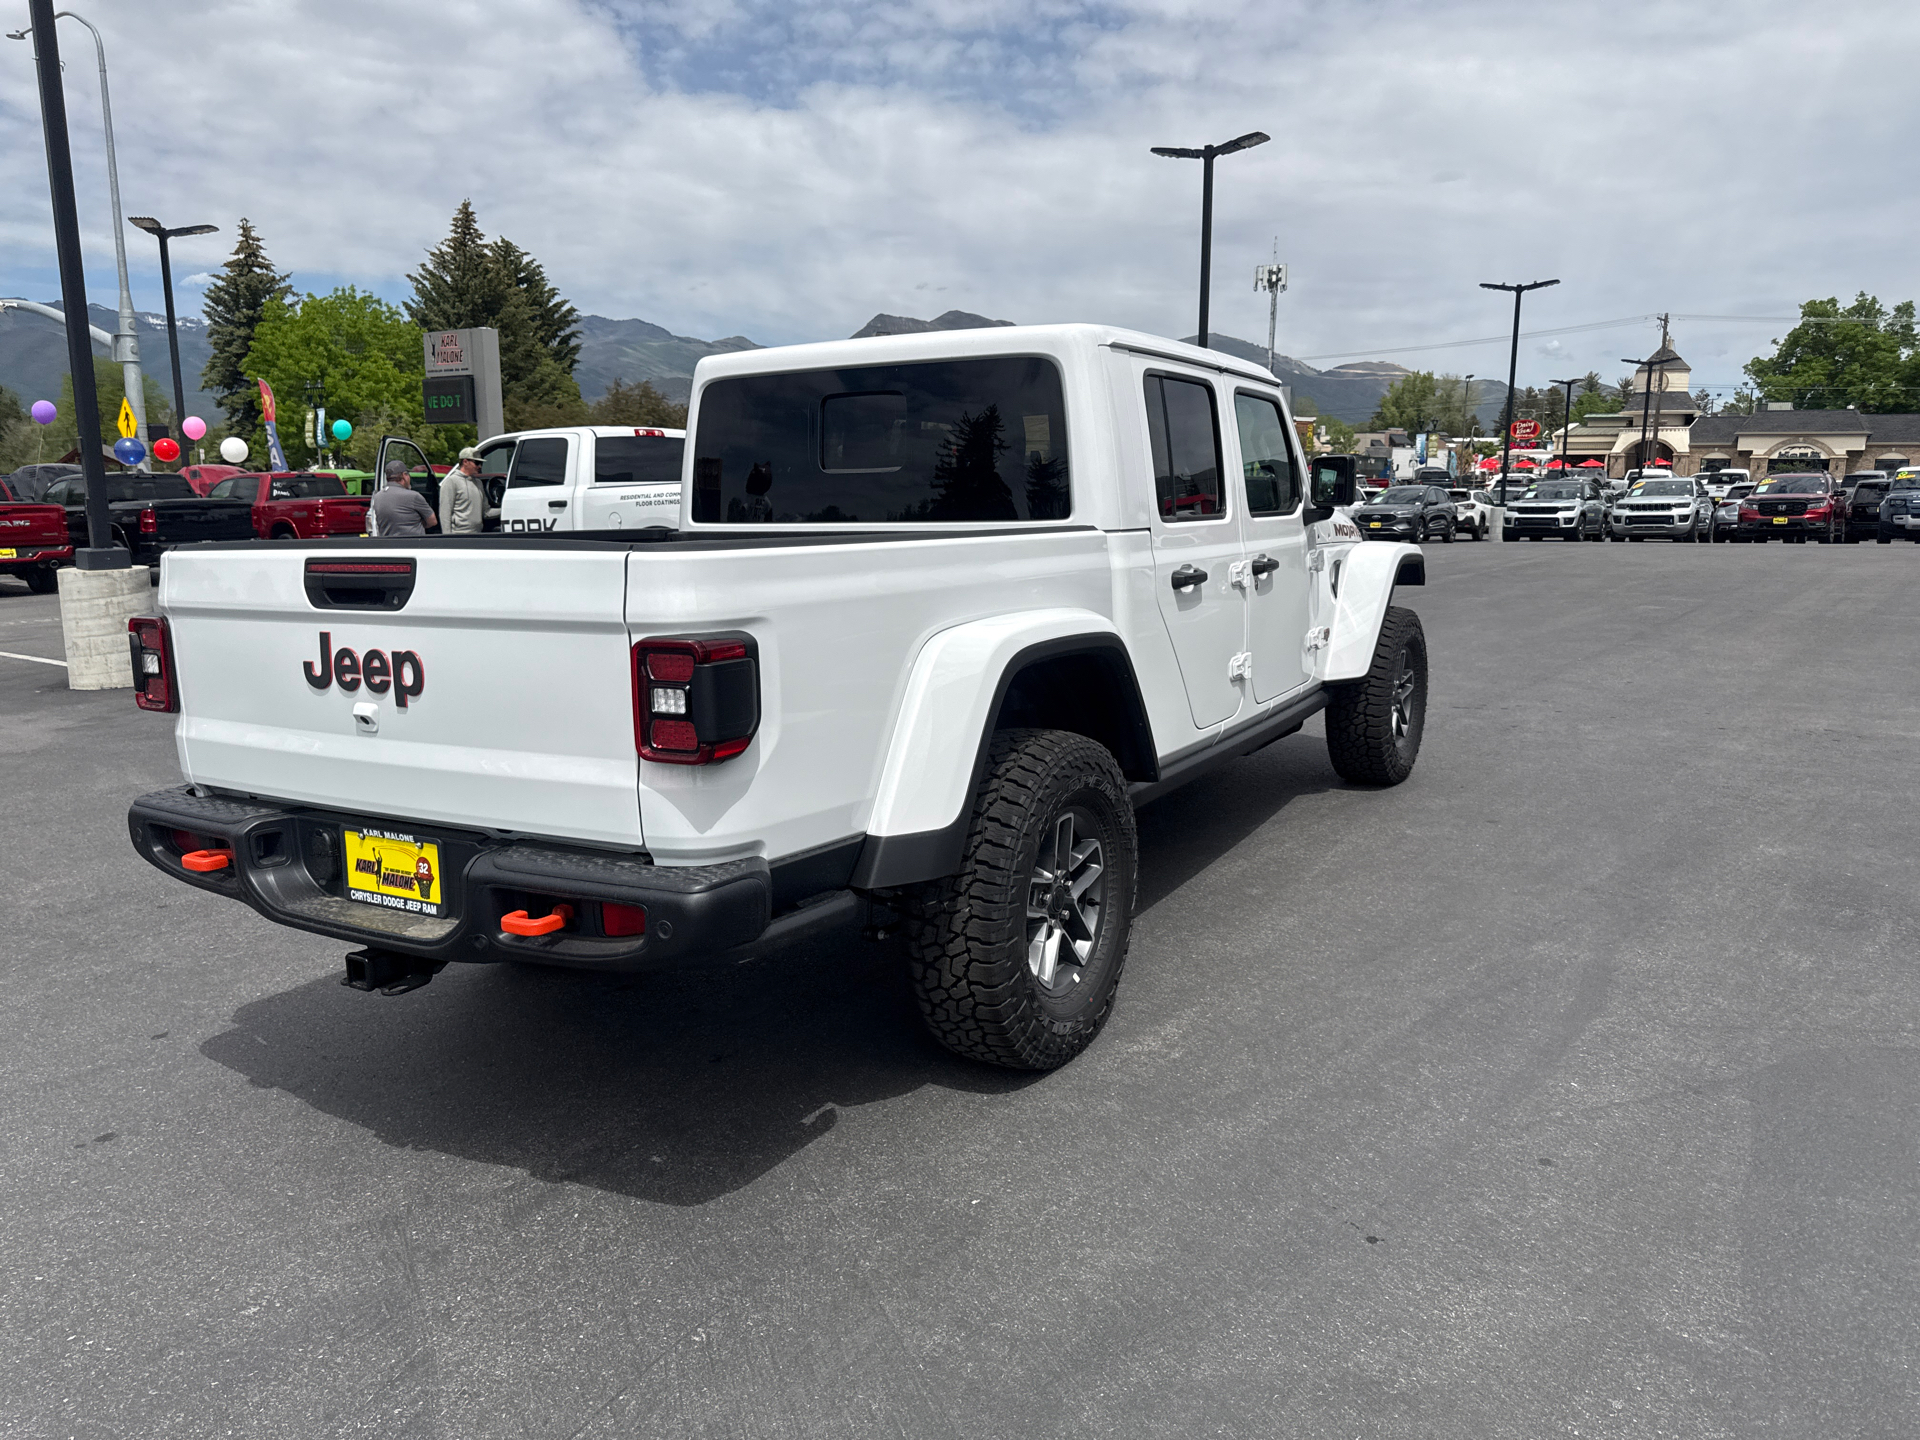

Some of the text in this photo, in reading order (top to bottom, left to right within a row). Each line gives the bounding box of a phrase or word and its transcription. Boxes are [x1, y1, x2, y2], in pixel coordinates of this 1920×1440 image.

[441, 333, 459, 348] KARL
[436, 350, 464, 364] MALONE
[440, 395, 454, 408] DO
[620, 493, 652, 501] RESIDENTIAL
[302, 631, 425, 708] Jeep
[362, 828, 415, 843] KARL MALONE
[355, 857, 378, 875] KARL
[418, 862, 429, 875] 32
[381, 872, 416, 892] MALONE
[350, 889, 438, 915] CHRYSLER DODGE JEEP RAM
